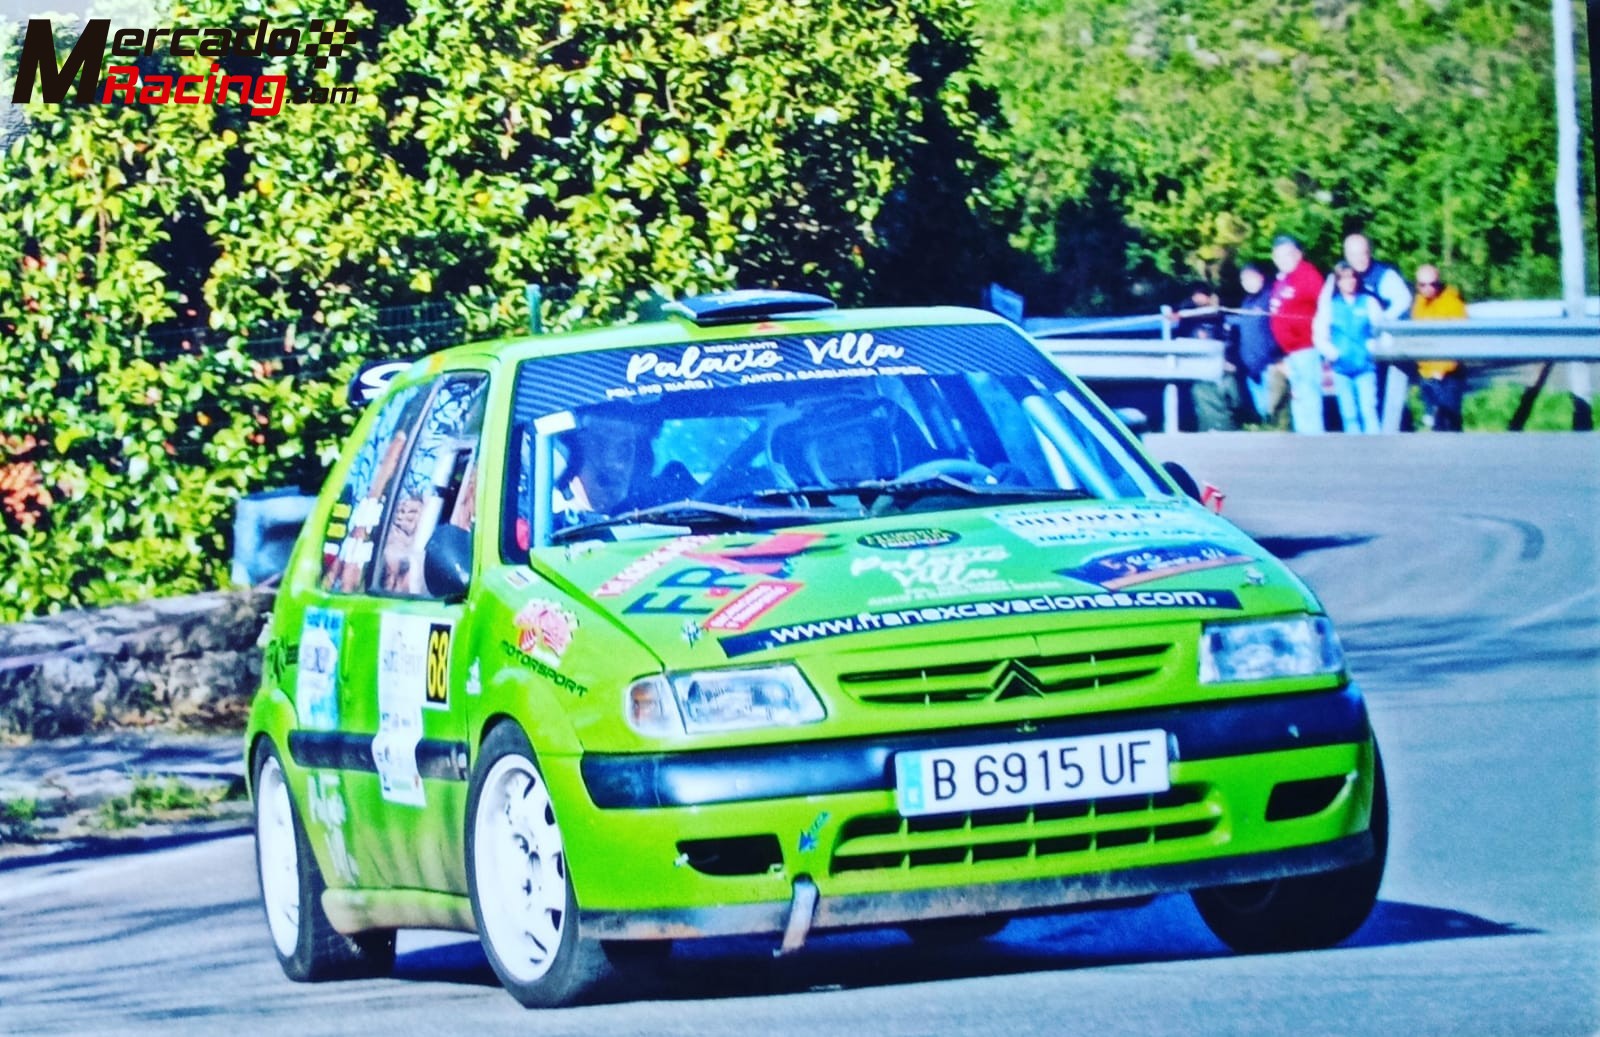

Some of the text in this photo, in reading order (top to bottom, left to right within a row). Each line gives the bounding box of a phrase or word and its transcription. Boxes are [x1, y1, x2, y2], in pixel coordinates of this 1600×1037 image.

[626, 332, 905, 384] Palacio Villa
[427, 630, 450, 700] 68
[932, 740, 1151, 801] B 6915 UF
